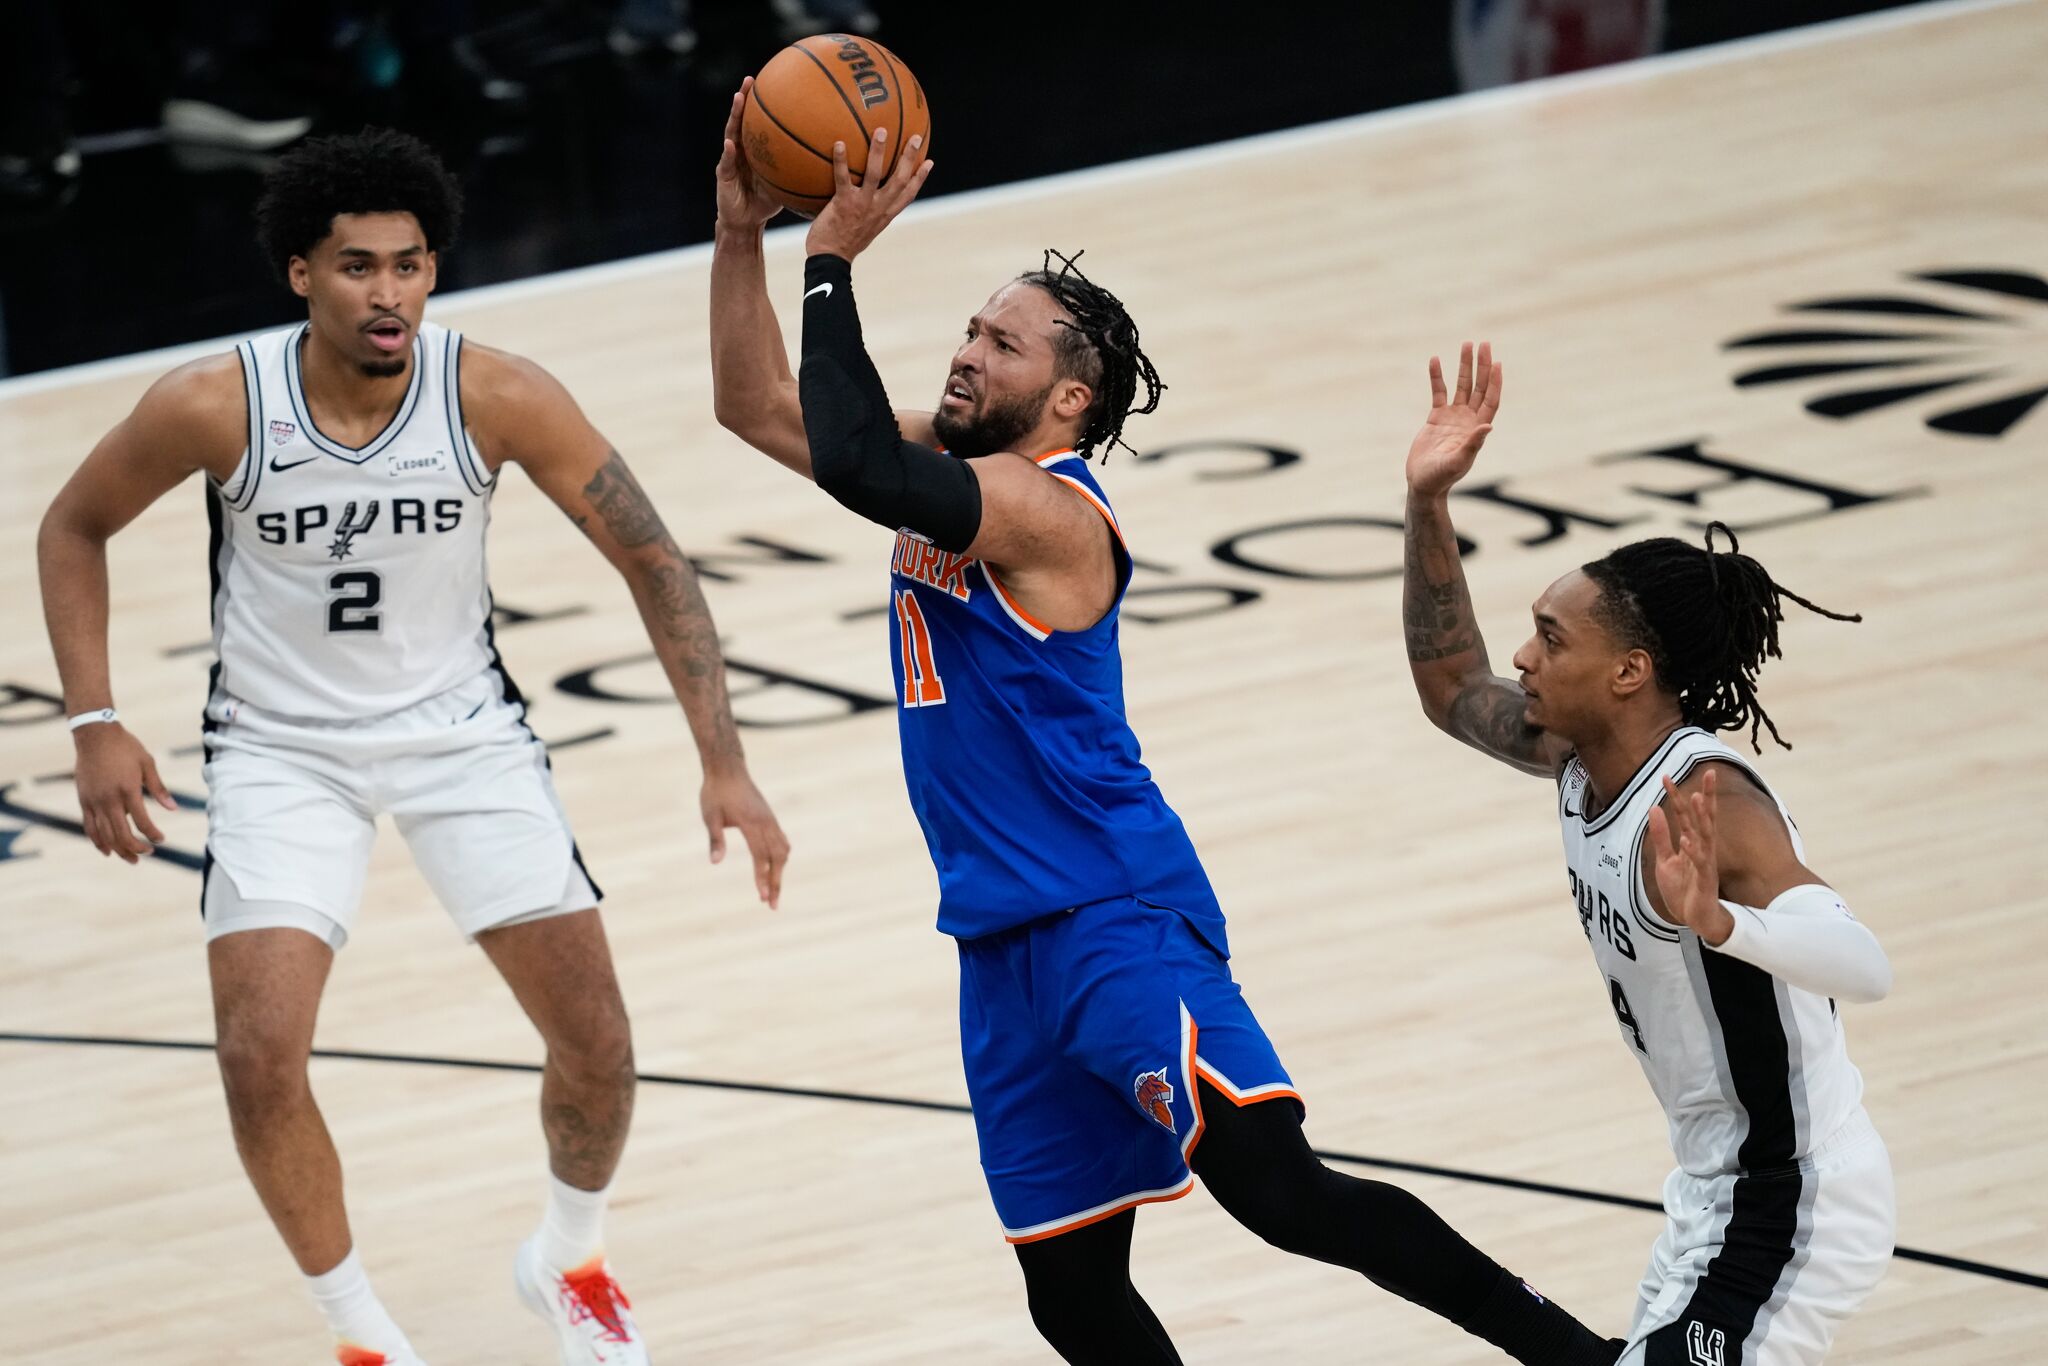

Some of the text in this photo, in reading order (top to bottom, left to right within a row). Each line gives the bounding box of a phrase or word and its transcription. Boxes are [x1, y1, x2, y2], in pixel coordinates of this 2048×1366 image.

[396, 457, 439, 472] LEDGER
[256, 498, 464, 560] SPURS
[326, 567, 382, 635] 2
[895, 588, 946, 709] 11
[1602, 854, 1619, 869] LEDGER
[1609, 976, 1649, 1056] 4
